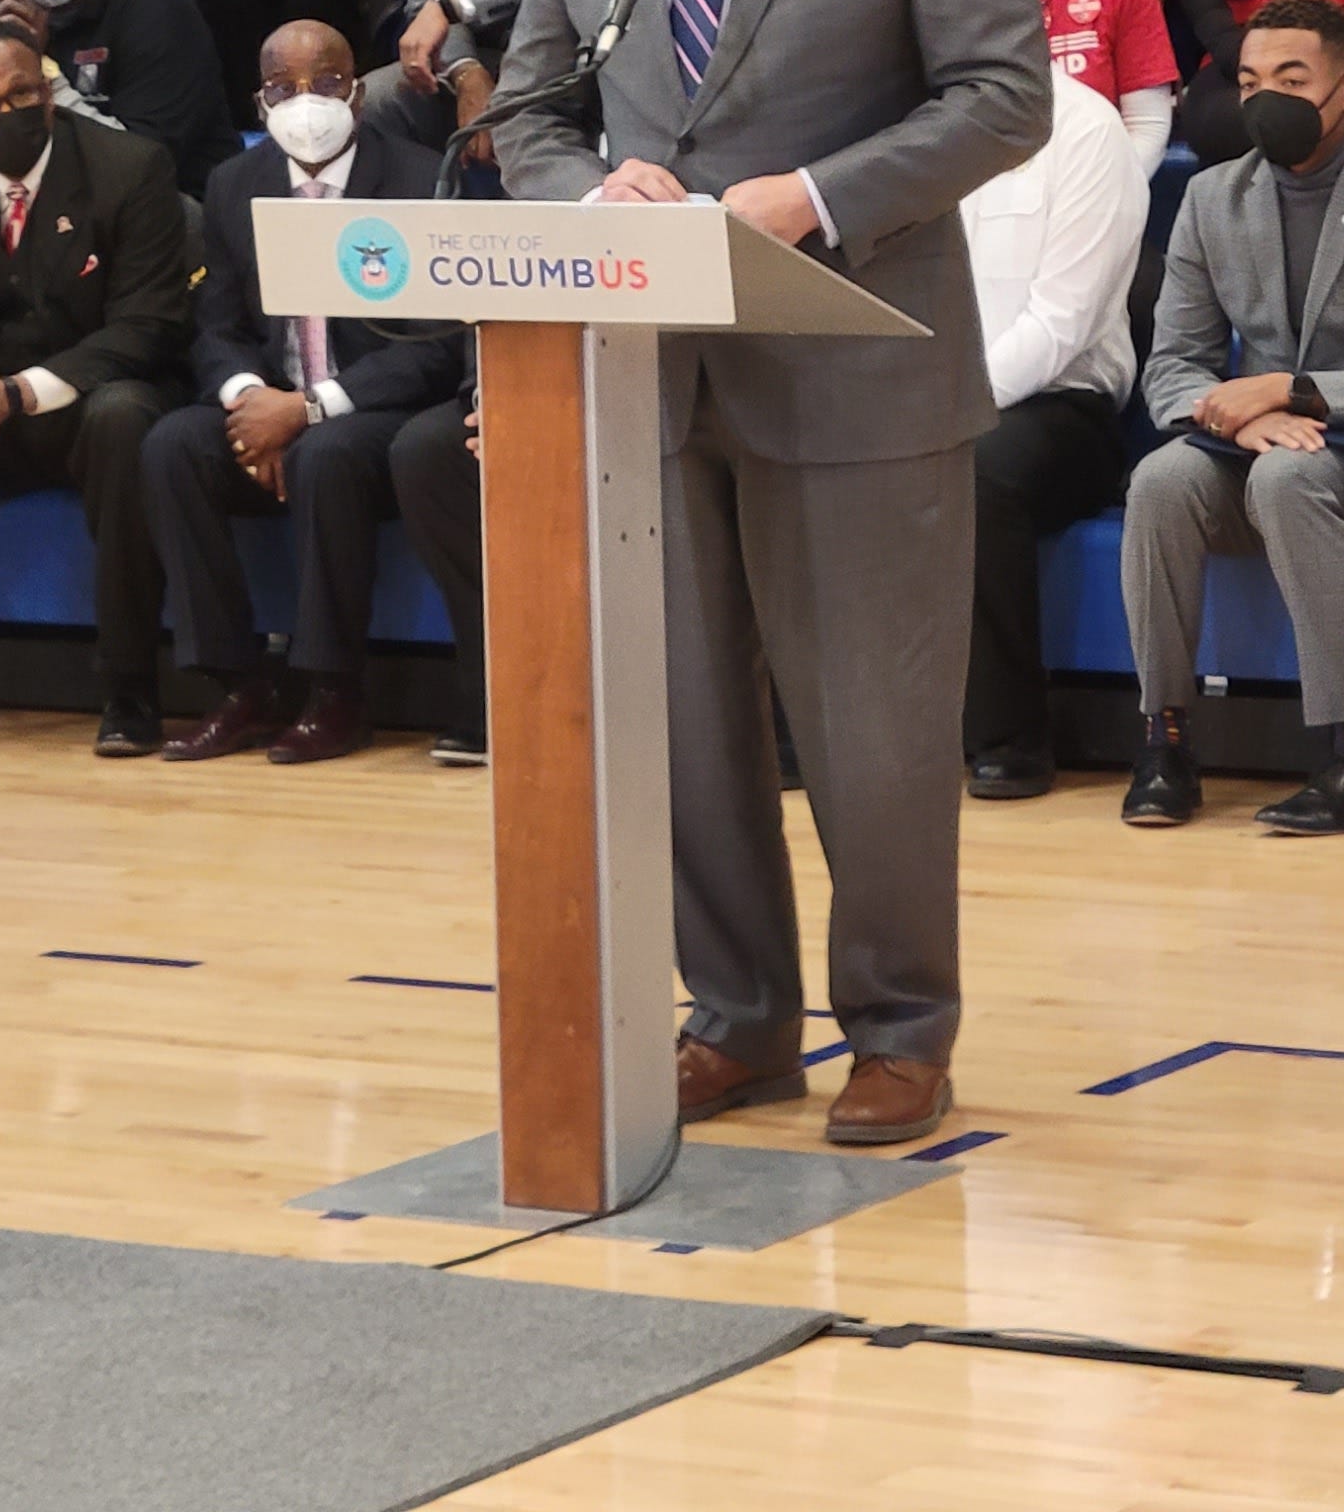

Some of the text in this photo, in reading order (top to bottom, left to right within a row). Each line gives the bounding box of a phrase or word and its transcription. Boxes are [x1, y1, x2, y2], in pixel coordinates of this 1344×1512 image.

[427, 234, 543, 251] THE CITY OF
[429, 252, 649, 290] COLUMBUS
